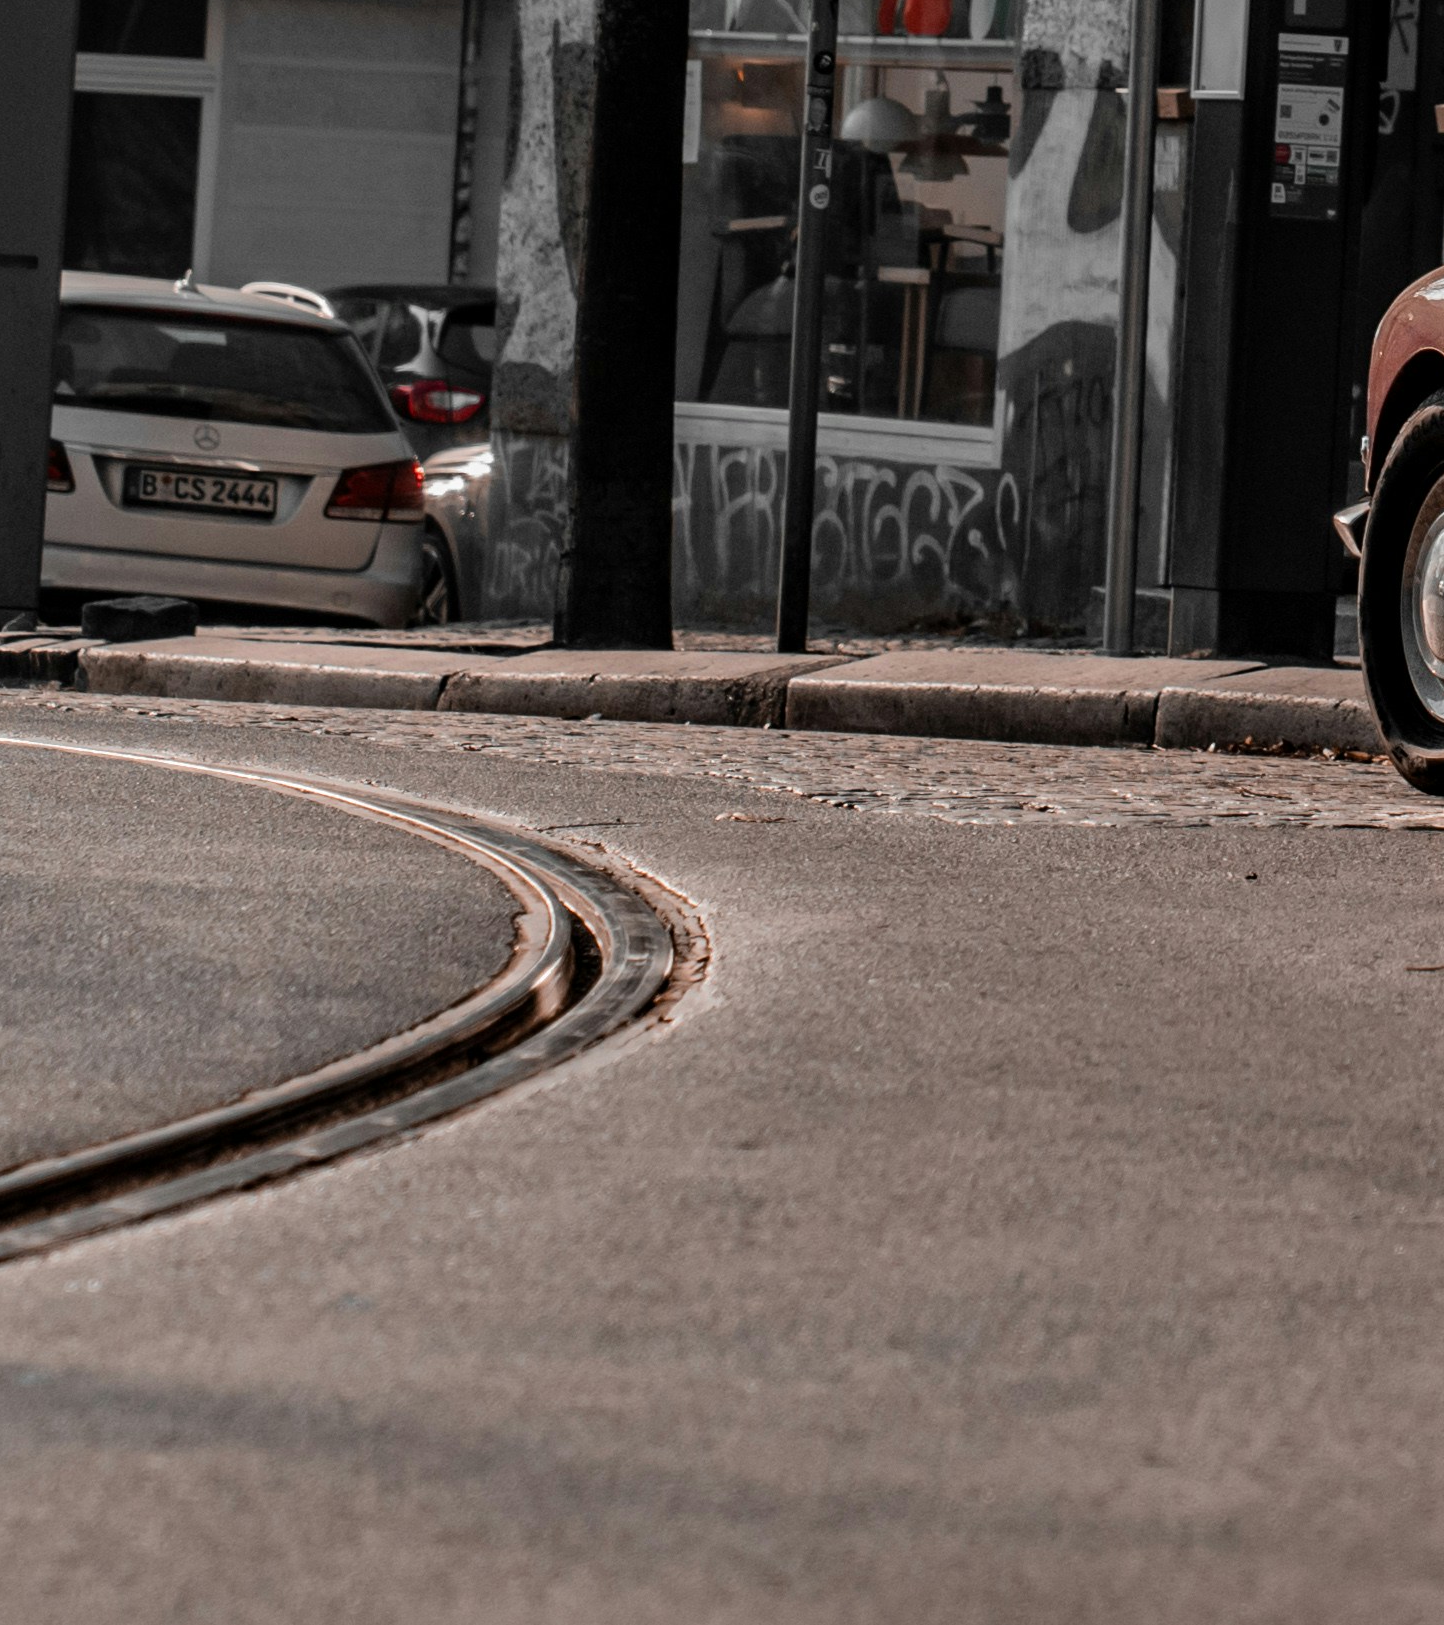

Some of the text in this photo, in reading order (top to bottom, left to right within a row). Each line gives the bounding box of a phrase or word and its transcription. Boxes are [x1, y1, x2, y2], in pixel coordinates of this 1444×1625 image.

[142, 474, 270, 508] B CS 2444
